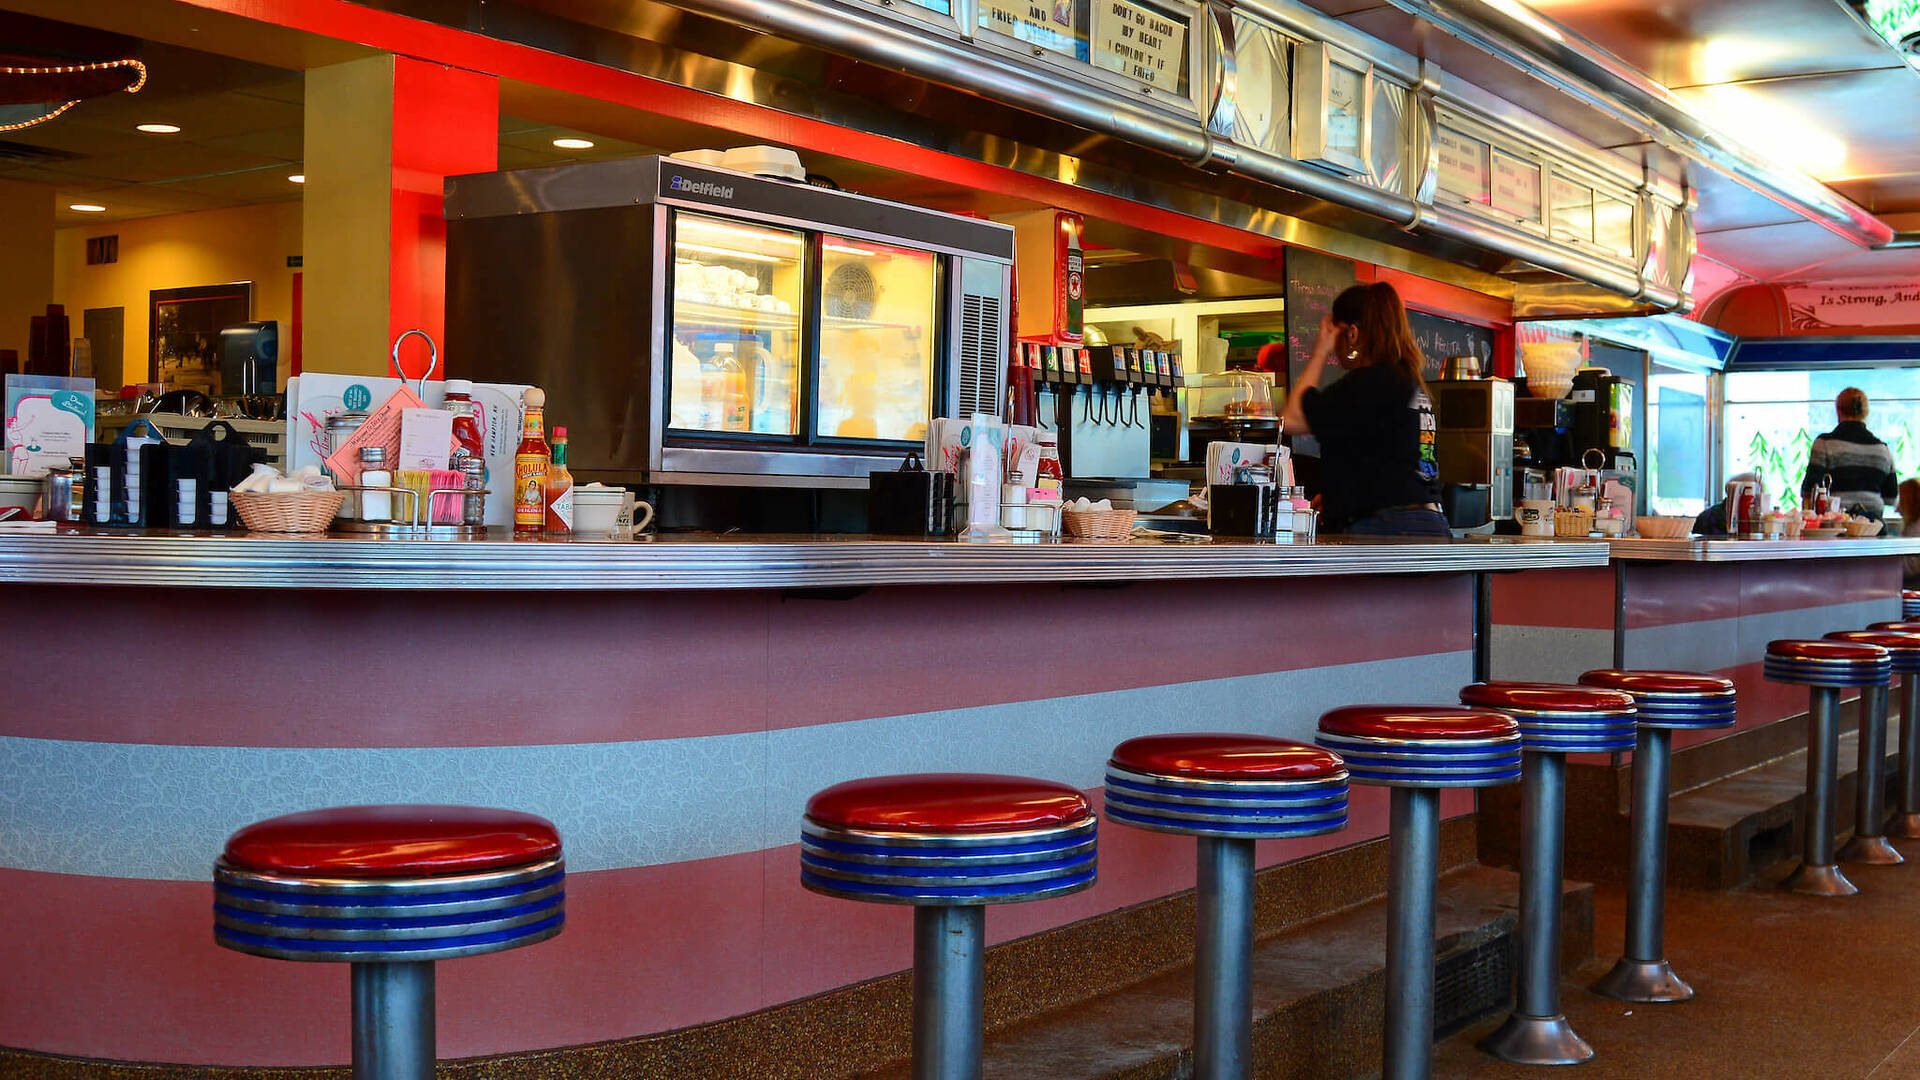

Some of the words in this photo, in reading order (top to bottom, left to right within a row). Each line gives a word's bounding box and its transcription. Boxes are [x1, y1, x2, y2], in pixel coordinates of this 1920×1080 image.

[1029, 6, 1047, 22] AND
[1136, 13, 1146, 26] GO
[1150, 18, 1174, 38] BACON
[1122, 24, 1134, 38] MY
[1139, 31, 1162, 50] HEART
[1157, 58, 1165, 70] IF
[1133, 65, 1156, 82] FRIED
[682, 179, 734, 199] Delfield
[1821, 295, 1834, 306] Is
